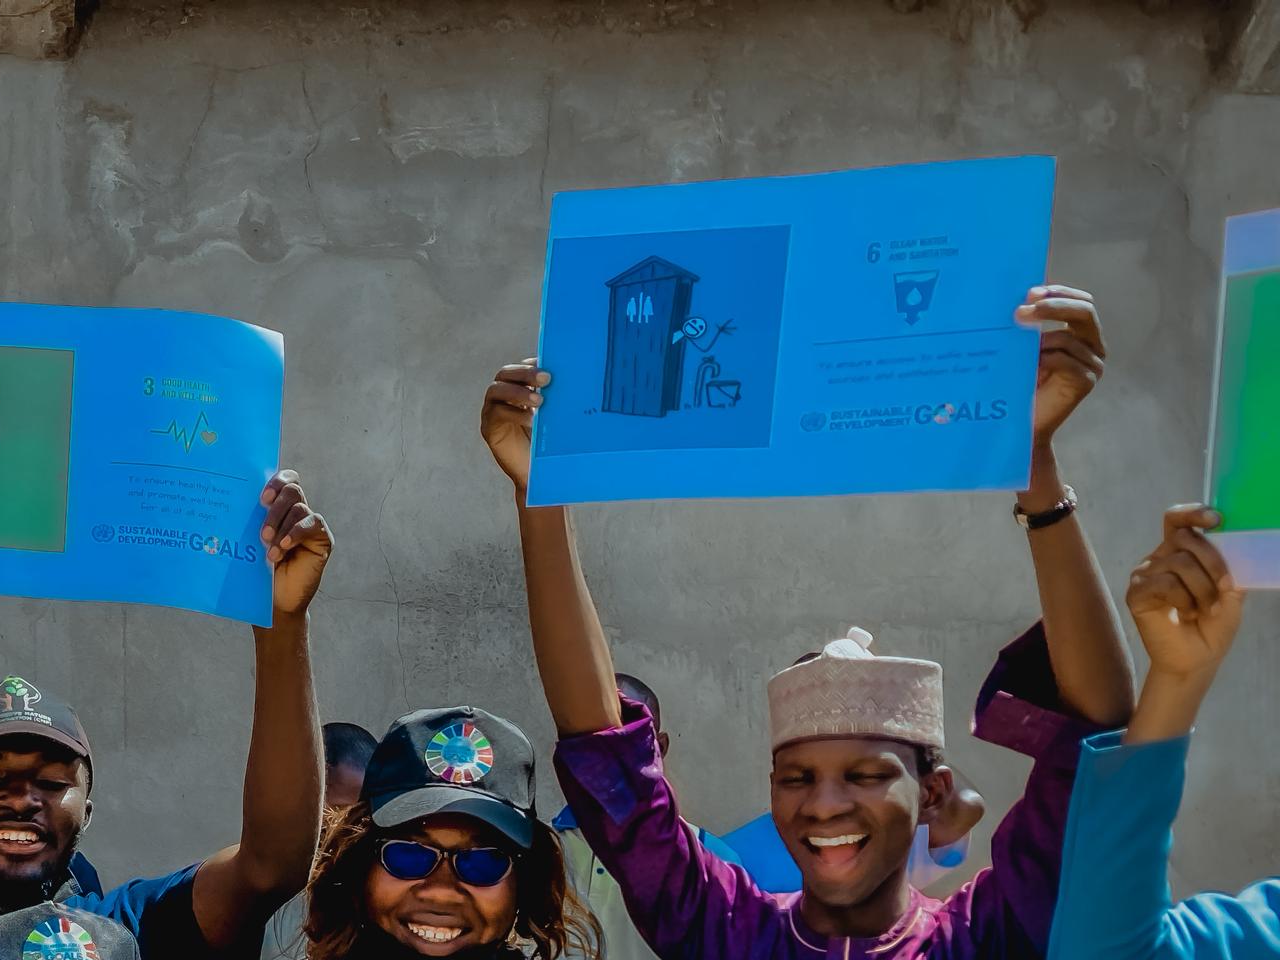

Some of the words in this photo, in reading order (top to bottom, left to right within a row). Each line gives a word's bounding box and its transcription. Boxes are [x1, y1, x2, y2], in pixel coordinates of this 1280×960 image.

[867, 242, 882, 264] 6
[144, 378, 154, 396] 3
[914, 400, 1008, 425] GOALS
[830, 417, 912, 431] DEVELOPMENT
[118, 526, 188, 540] SUSTAINABLE
[118, 536, 187, 549] DEVELOPMENT
[189, 532, 257, 563] GOALS
